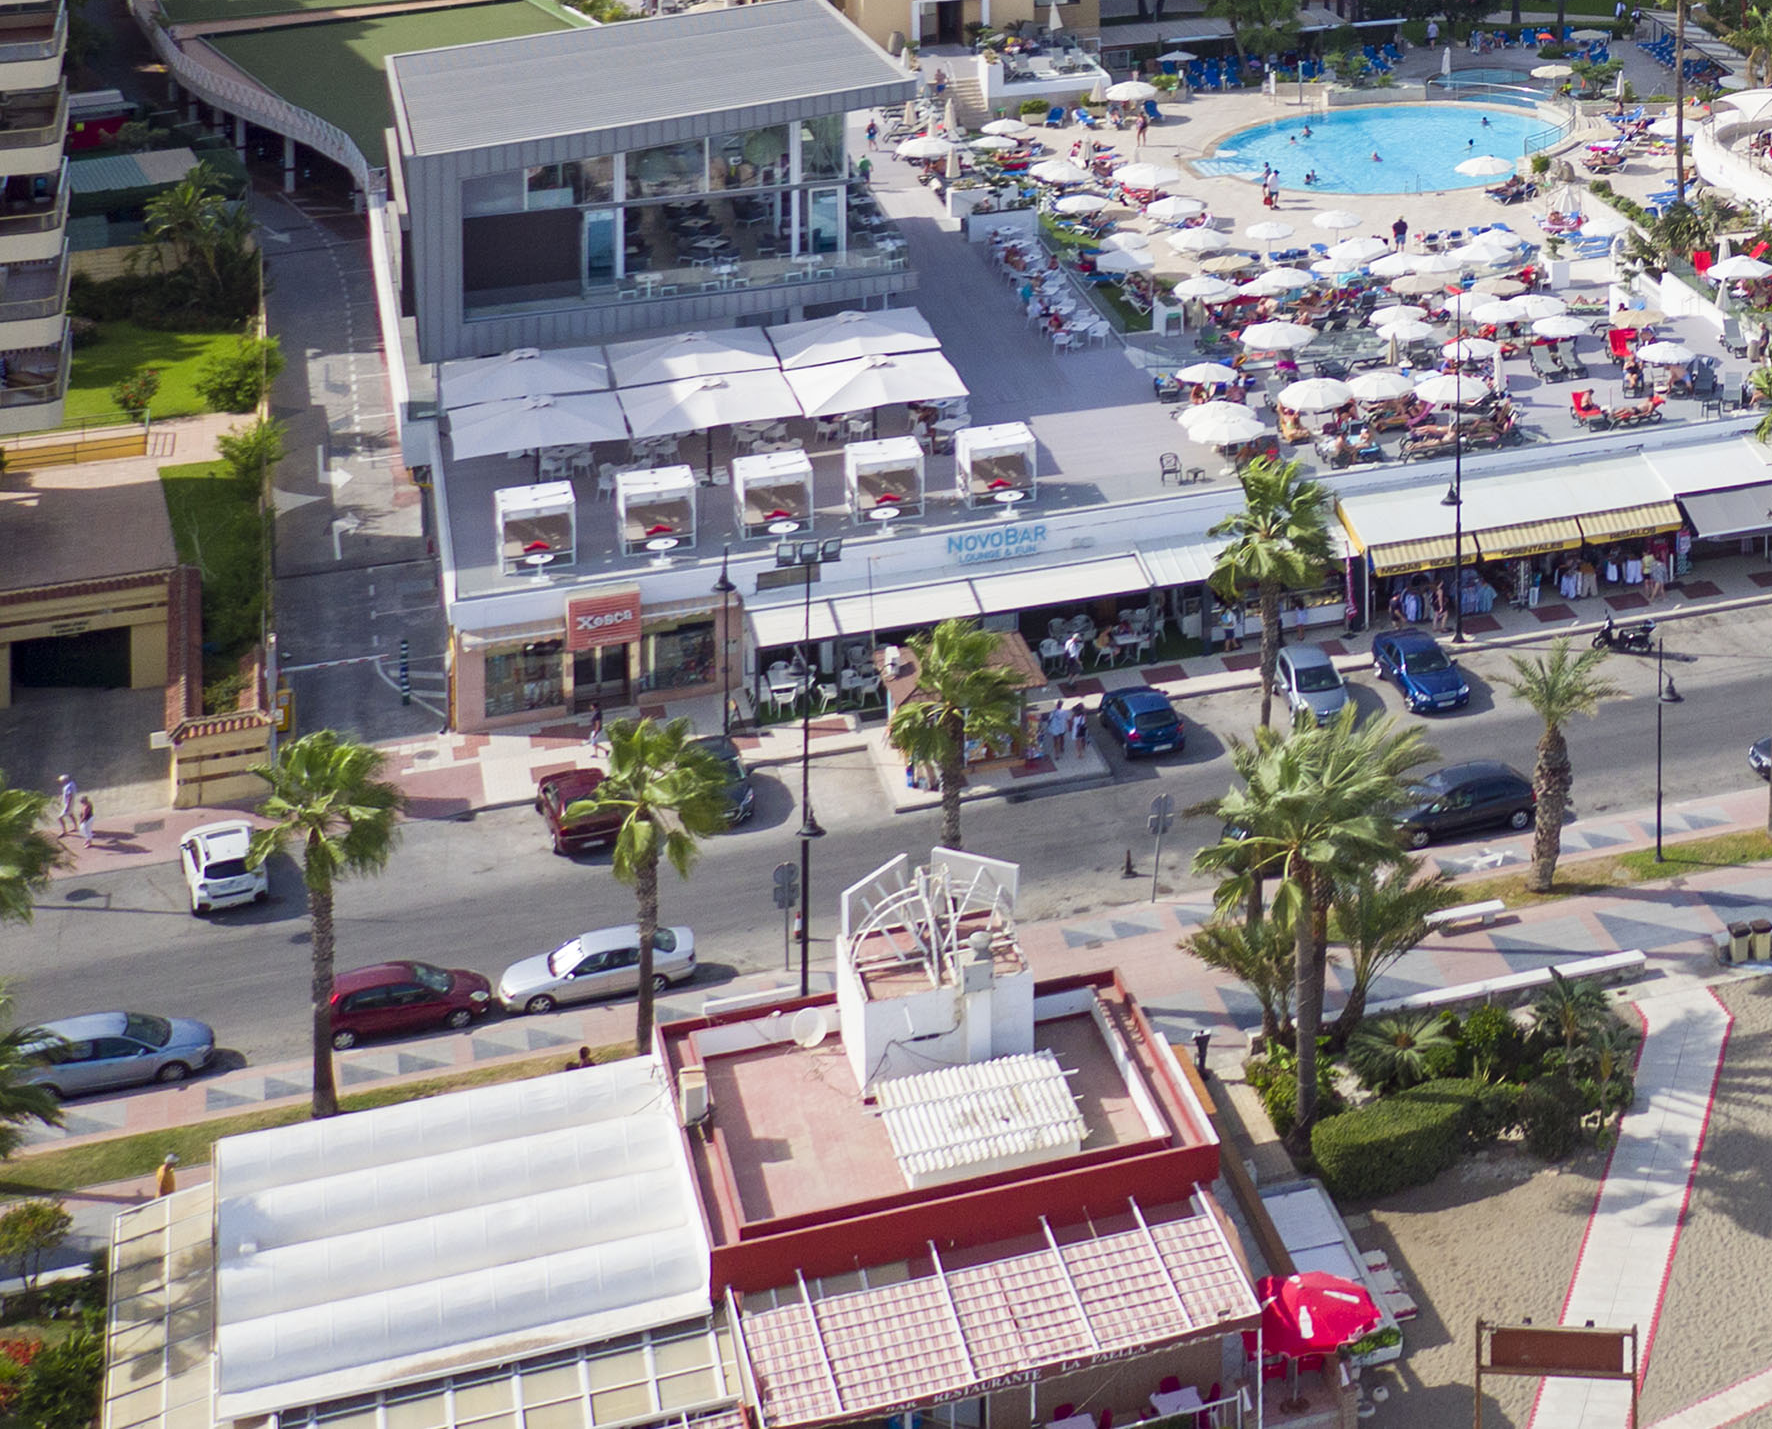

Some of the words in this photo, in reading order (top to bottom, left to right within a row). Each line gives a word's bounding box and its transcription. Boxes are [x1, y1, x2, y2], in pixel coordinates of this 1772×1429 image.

[959, 550, 1000, 564] LOUNGE
[1015, 545, 1037, 555] FUN
[1501, 542, 1564, 557] ORIENTALES
[1381, 561, 1422, 575] MODAS
[932, 1369, 1042, 1404] RESTAURANTE
[1061, 1359, 1081, 1372] LA
[1091, 1344, 1147, 1364] PAELLA
